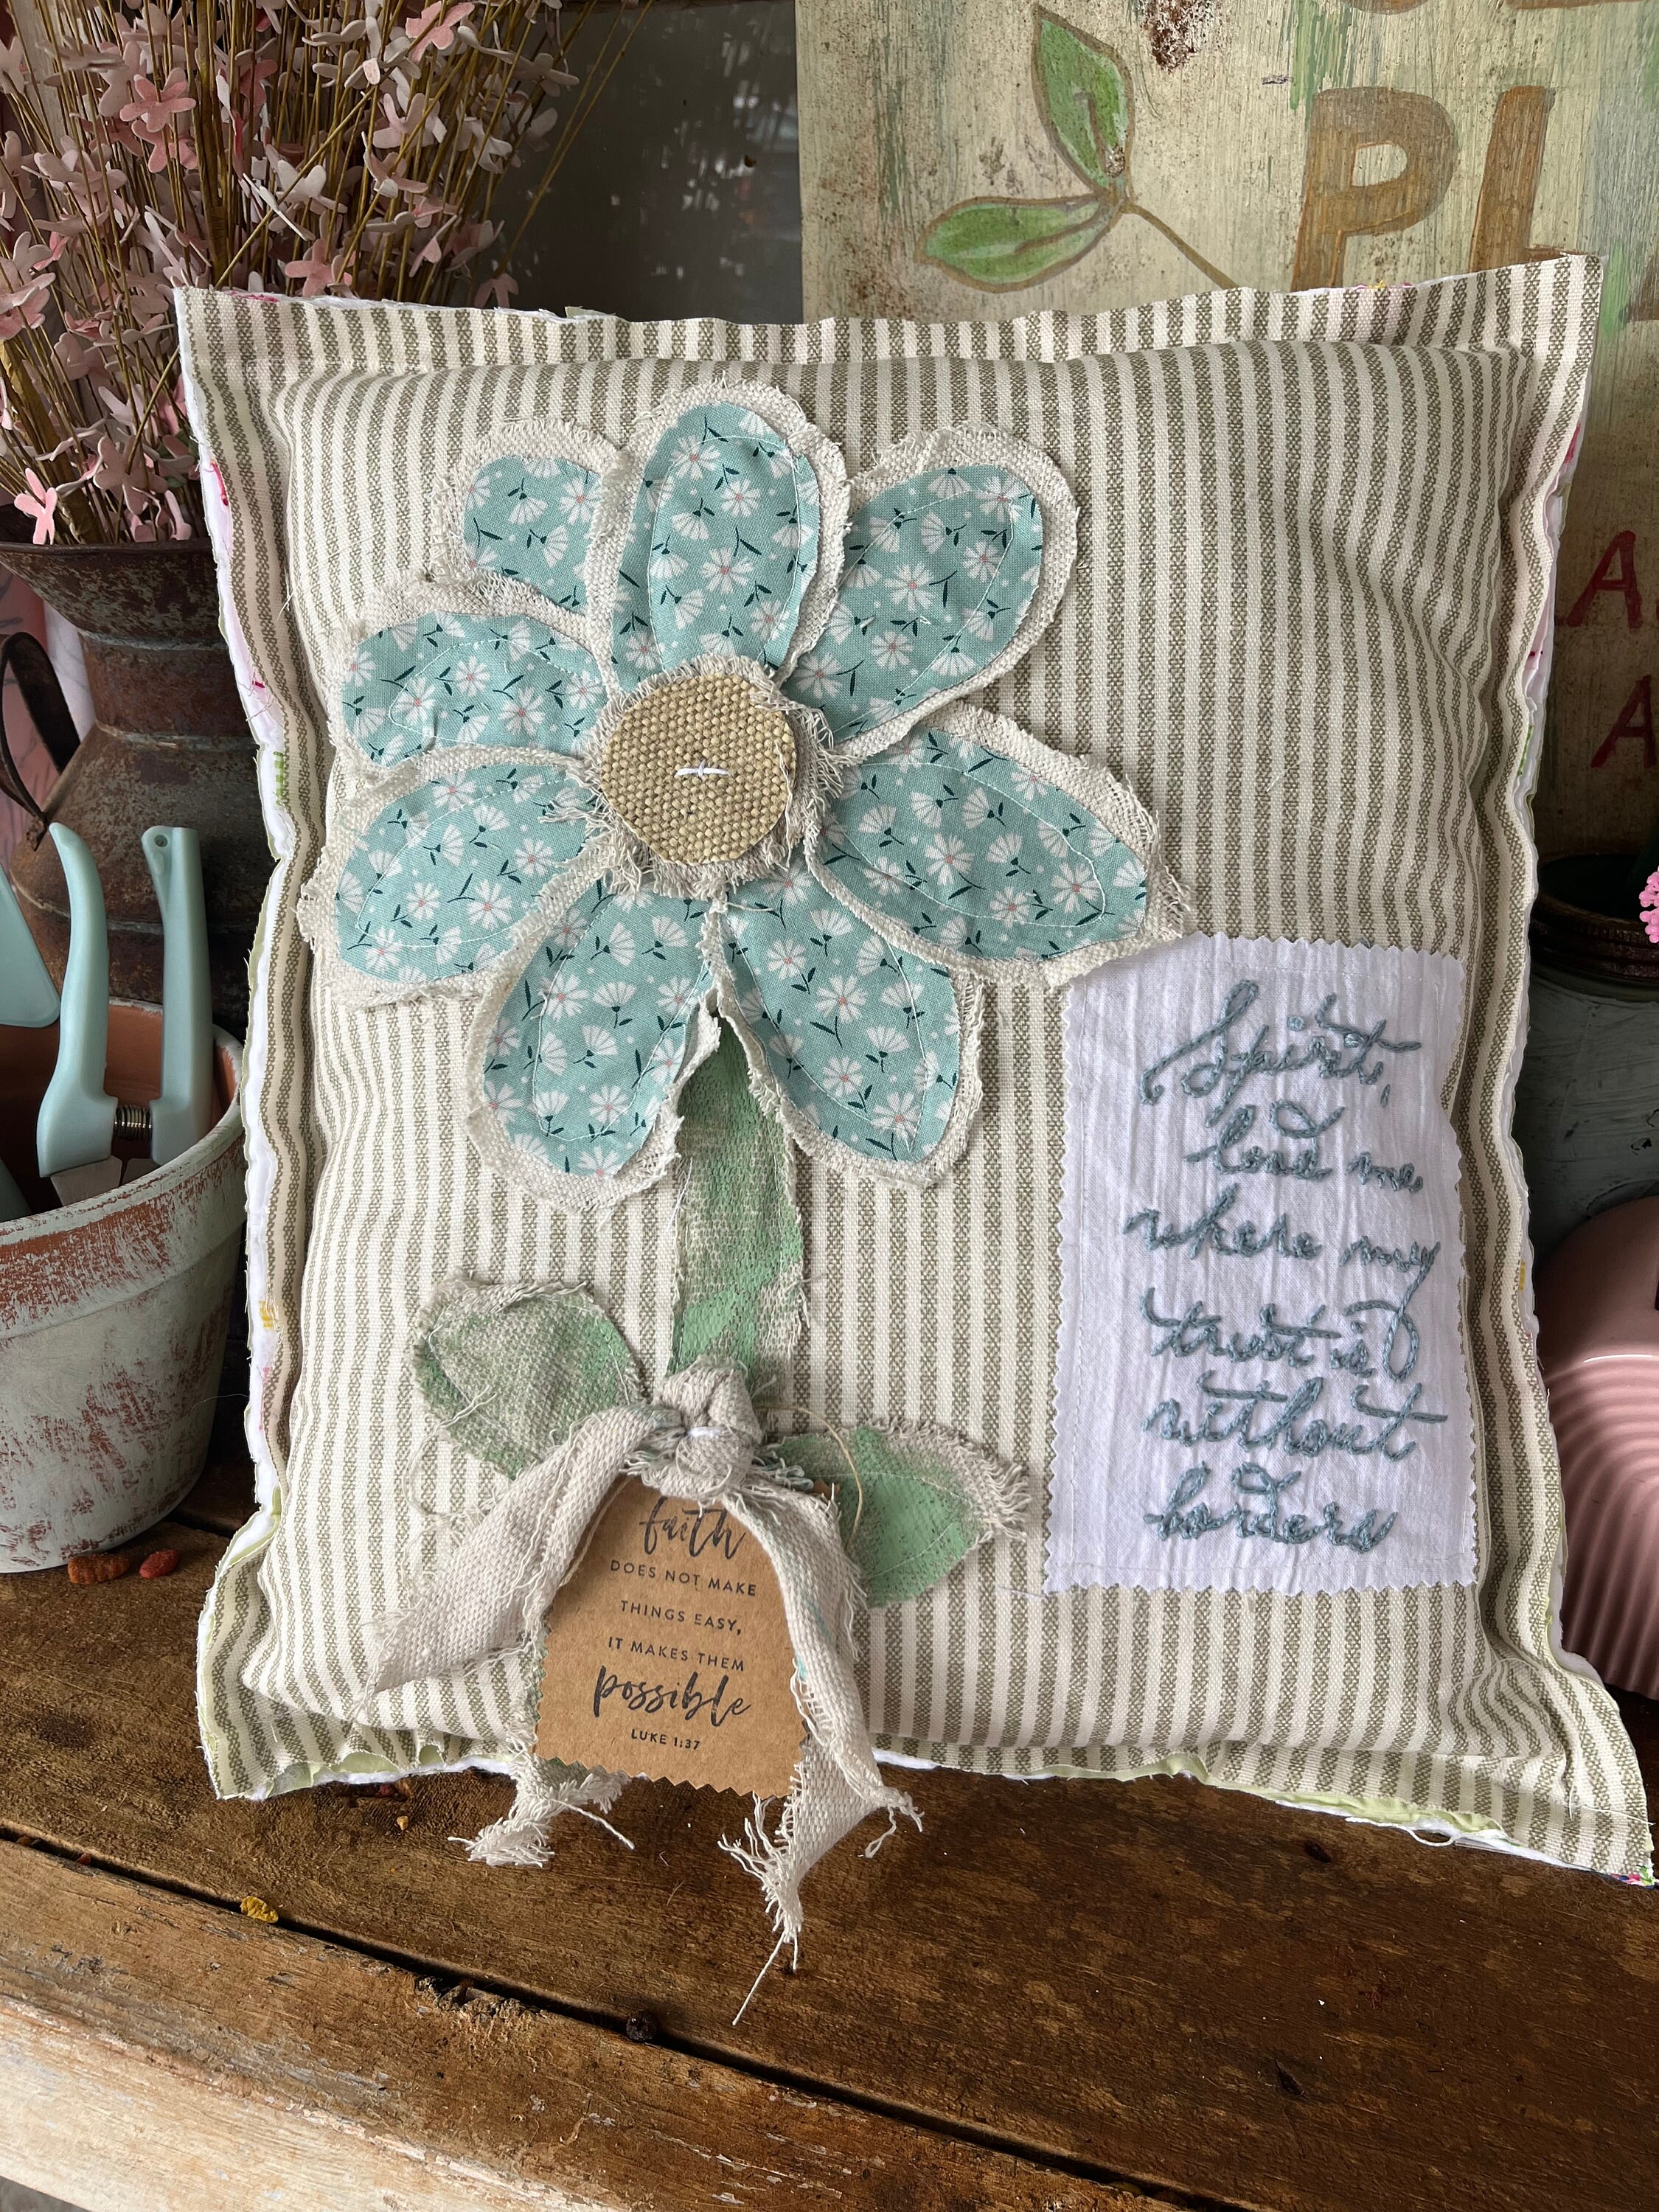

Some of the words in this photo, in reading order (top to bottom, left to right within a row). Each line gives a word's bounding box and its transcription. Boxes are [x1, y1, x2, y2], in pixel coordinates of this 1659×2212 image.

[1290, 85, 1659, 320] PL
[1186, 1100, 1343, 1180] lead
[1346, 1152, 1423, 1192] me
[1122, 1184, 1322, 1259] where
[1339, 1236, 1441, 1381] my
[1140, 1287, 1340, 1368] trust
[1329, 1321, 1377, 1378] is
[1142, 1370, 1448, 1462] without
[639, 1497, 747, 1560] faith
[1144, 1461, 1398, 1553] borders
[611, 1559, 657, 1579] DOES
[665, 1571, 701, 1587] NOT
[708, 1578, 757, 1596] MAKE
[608, 1636, 623, 1649] IT
[631, 1641, 689, 1662] MAKES
[697, 1652, 745, 1672] THEM
[620, 1600, 686, 1623] THINGS
[694, 1614, 742, 1635] EASY,
[593, 1665, 751, 1727] possible
[631, 1729, 667, 1745] LUKE
[673, 1737, 701, 1750] 1:37
